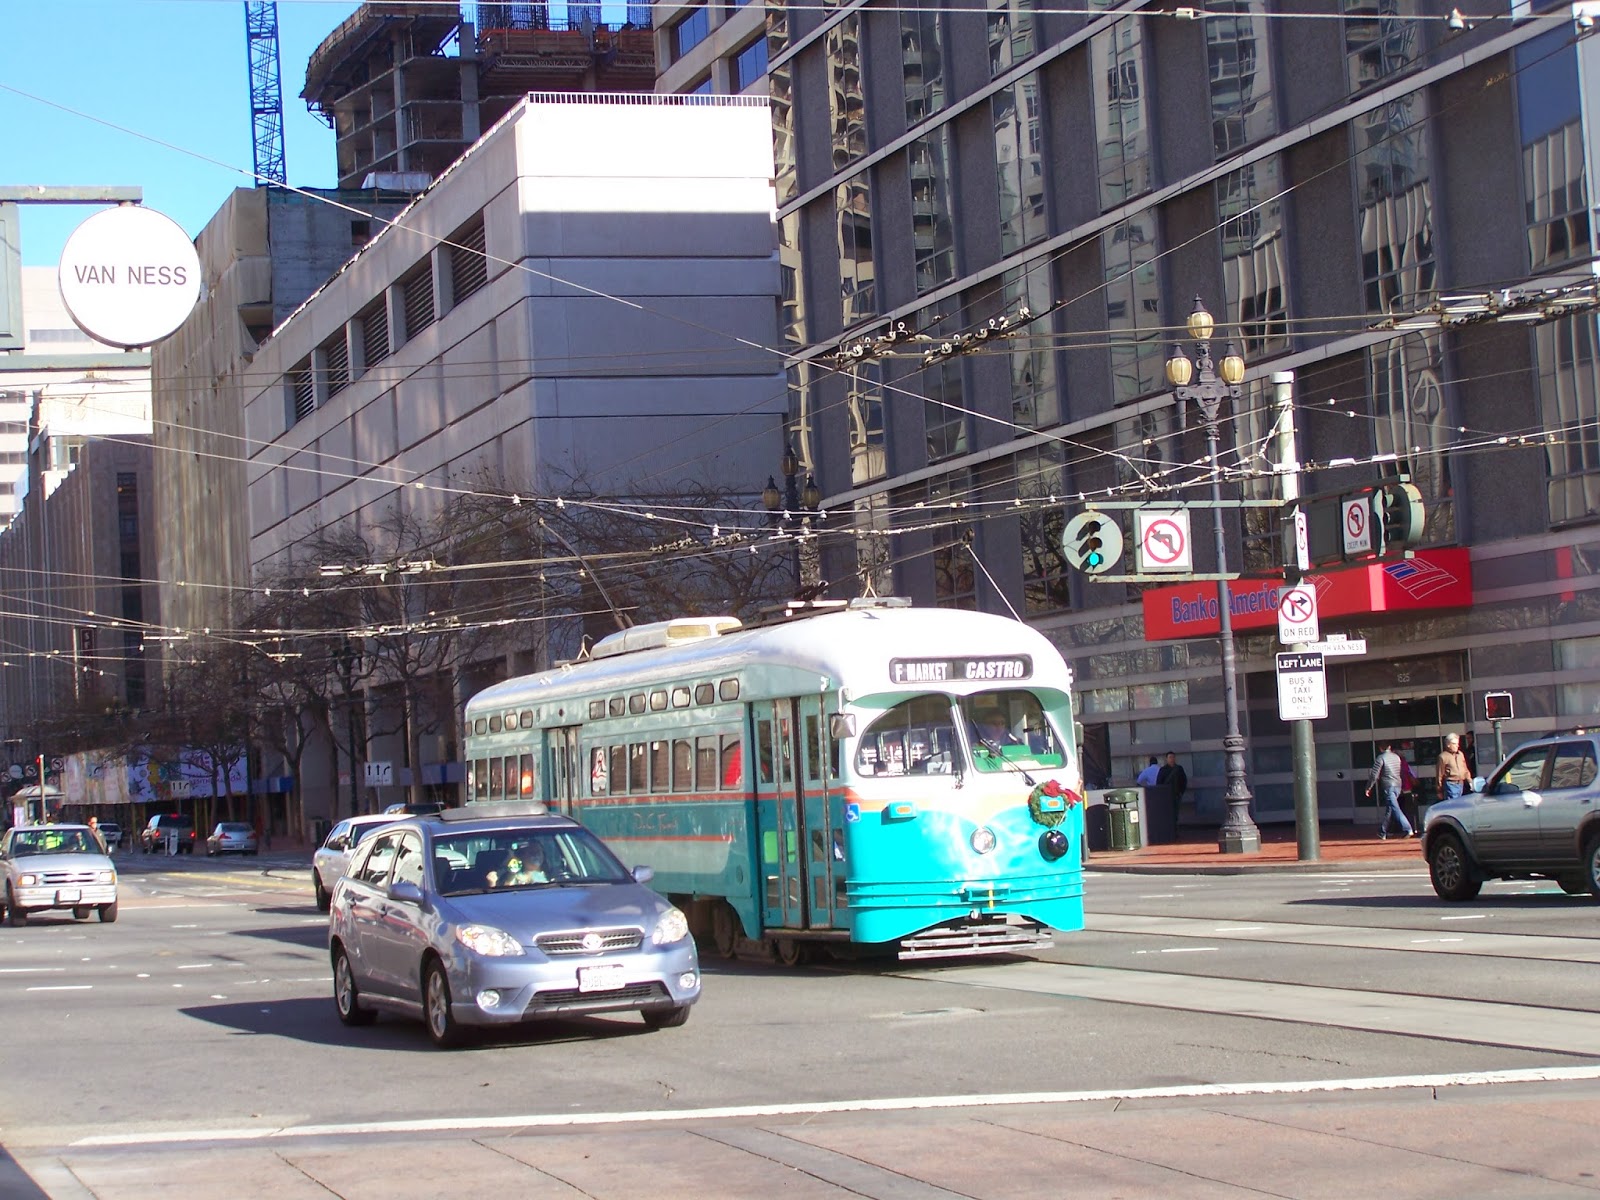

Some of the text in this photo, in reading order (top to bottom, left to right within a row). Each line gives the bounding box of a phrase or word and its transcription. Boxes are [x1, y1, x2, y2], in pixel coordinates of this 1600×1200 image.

[74, 265, 187, 286] VAN NESS
[1171, 593, 1208, 624] Bank
[1227, 582, 1280, 616] Americ
[1283, 626, 1315, 637] ON RED
[1333, 643, 1346, 651] VAN
[1347, 643, 1363, 651] NESS
[1278, 658, 1322, 669] LEFT LANE
[895, 660, 1024, 681] F MARKET CASTRO
[1289, 677, 1305, 685] BUS
[1293, 686, 1311, 694] TAXI
[1291, 695, 1313, 704] ONLY
